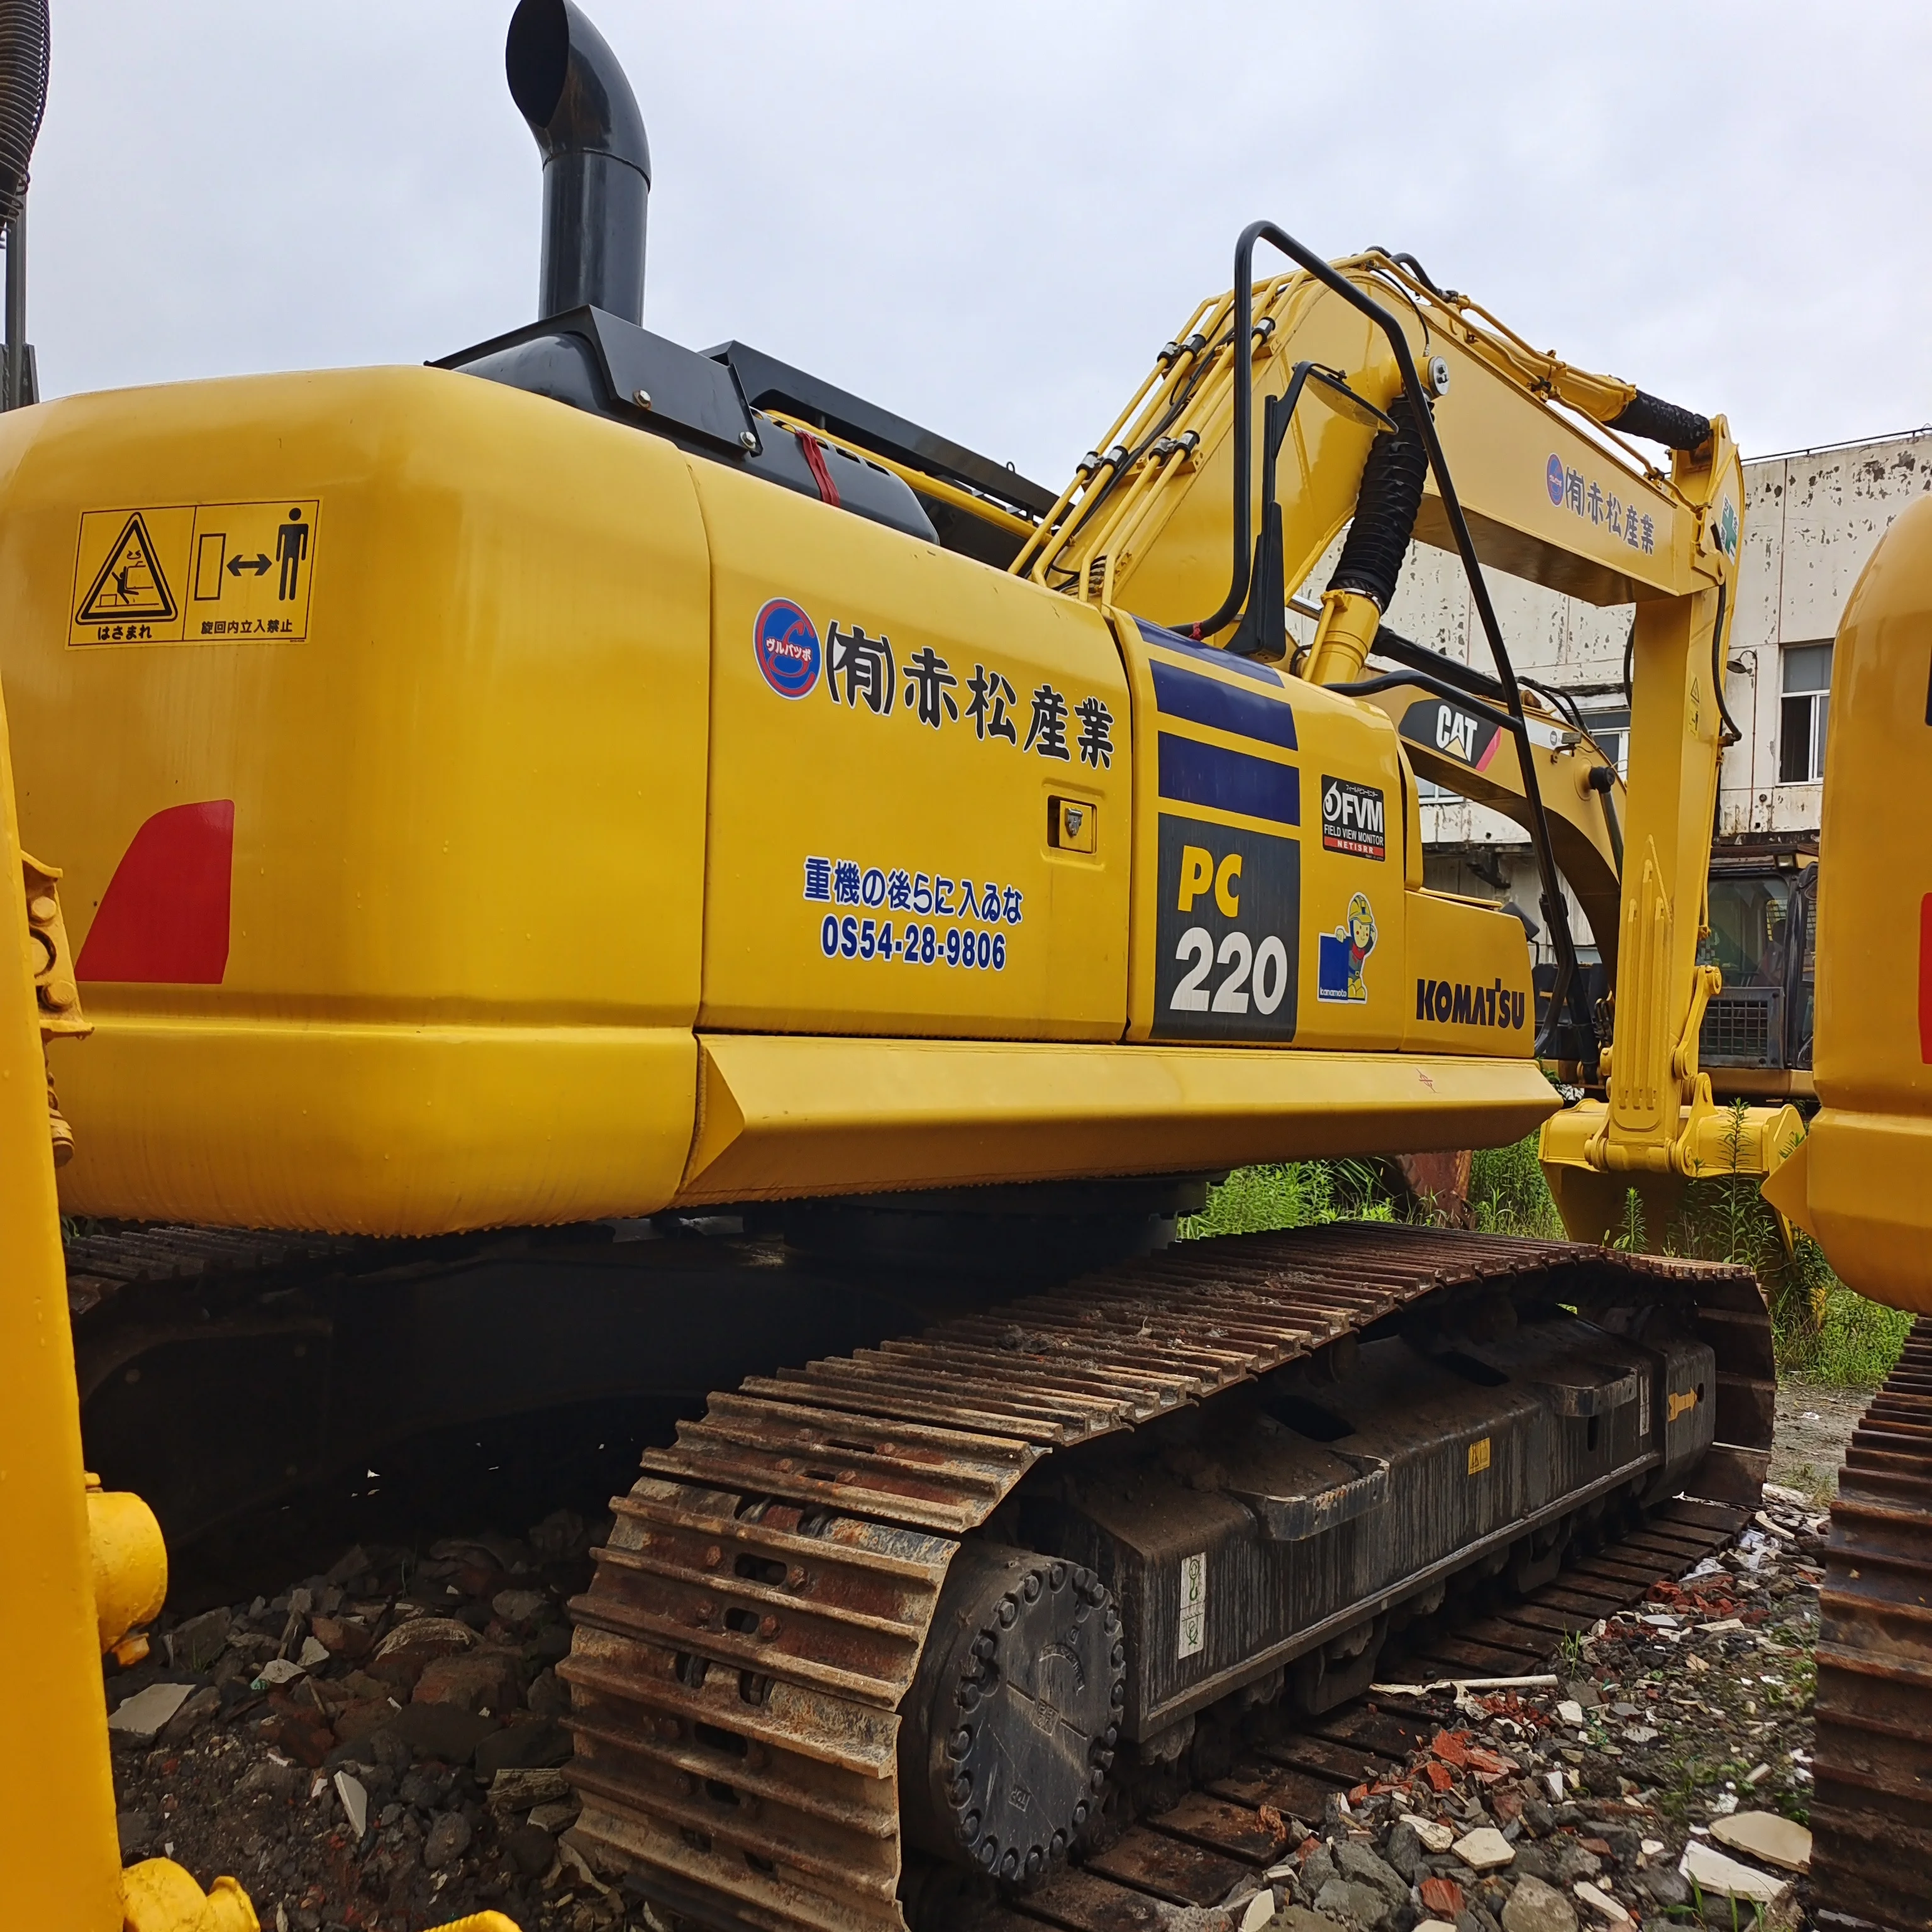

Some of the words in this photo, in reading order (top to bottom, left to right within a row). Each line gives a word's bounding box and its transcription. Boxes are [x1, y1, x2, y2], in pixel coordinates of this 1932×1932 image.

[98, 625, 152, 640] はさまれ
[201, 619, 293, 635] 旋回内立入禁止
[1436, 705, 1478, 762] CAT
[1324, 823, 1341, 837] FIELD
[1342, 828, 1357, 841] VIEW
[1358, 831, 1384, 847] MONITOR
[1342, 792, 1384, 833] FVM
[1177, 845, 1243, 918] PC
[1170, 926, 1288, 1015] 220
[1416, 977, 1525, 1030] KOMATSU
